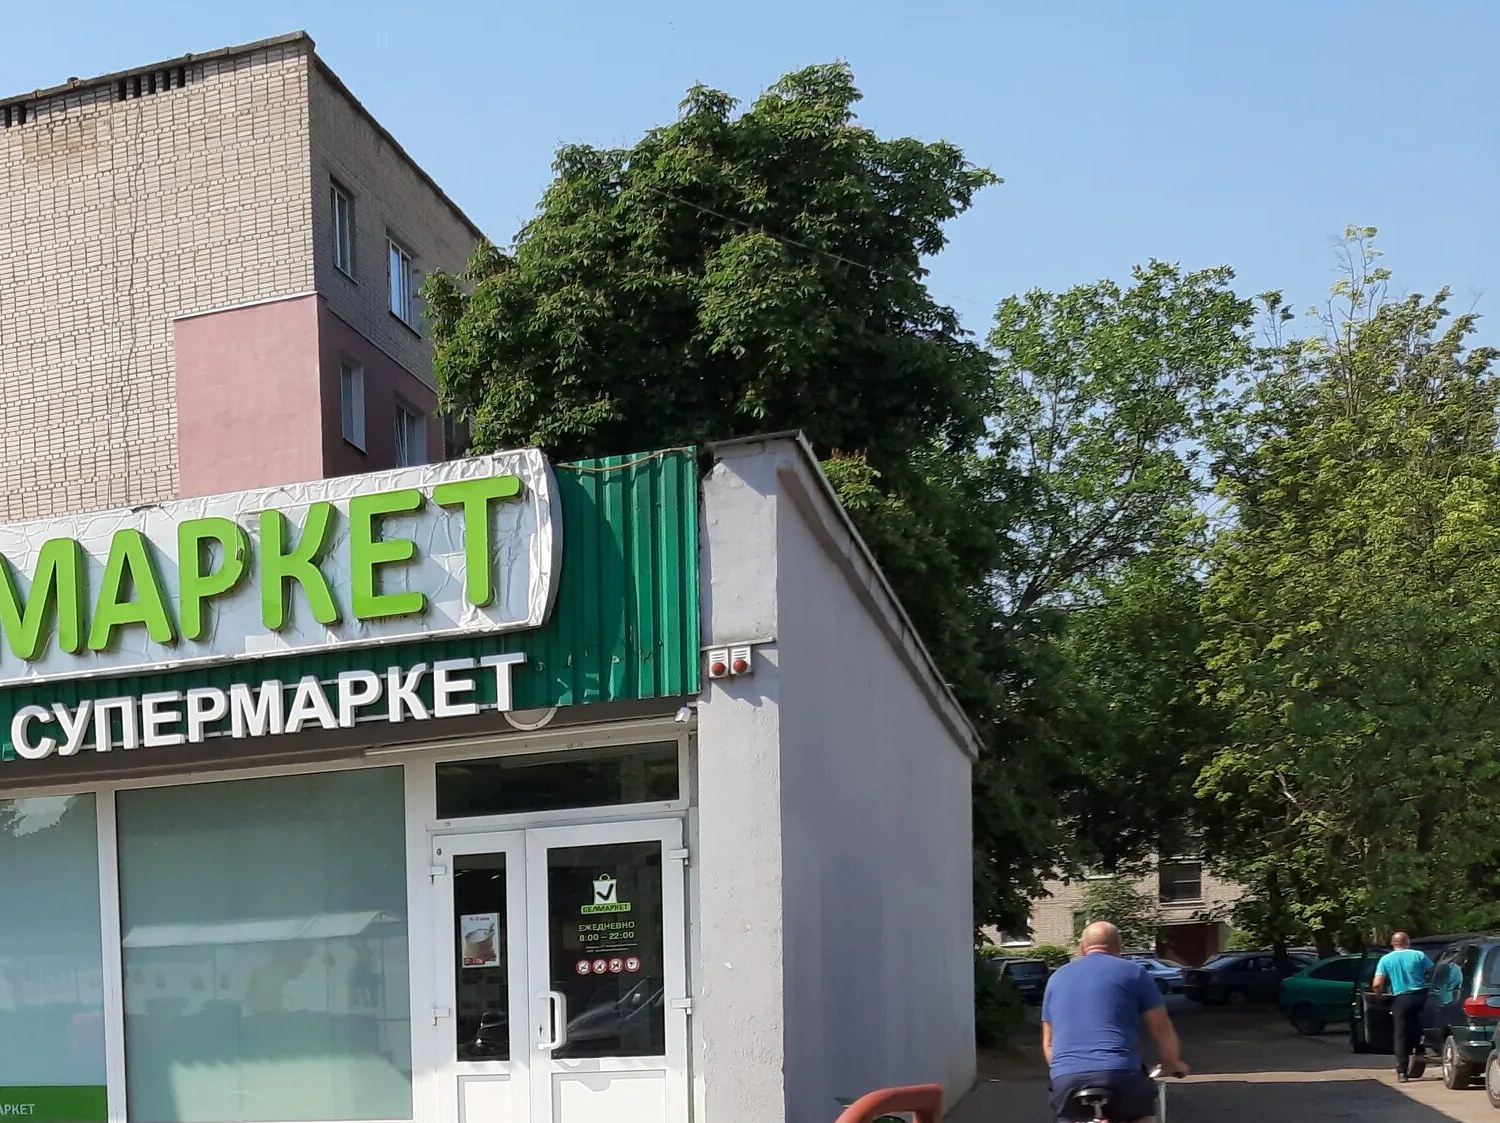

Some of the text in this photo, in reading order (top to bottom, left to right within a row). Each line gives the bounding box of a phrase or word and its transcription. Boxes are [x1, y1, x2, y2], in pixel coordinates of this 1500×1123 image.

[12, 652, 526, 760] СУПЕРМАРКЕТ
[582, 904, 628, 913] БЕЛМАРКЕТ
[578, 921, 635, 932] ЕЖЕДНЕВНО
[609, 932, 635, 940] 22:00
